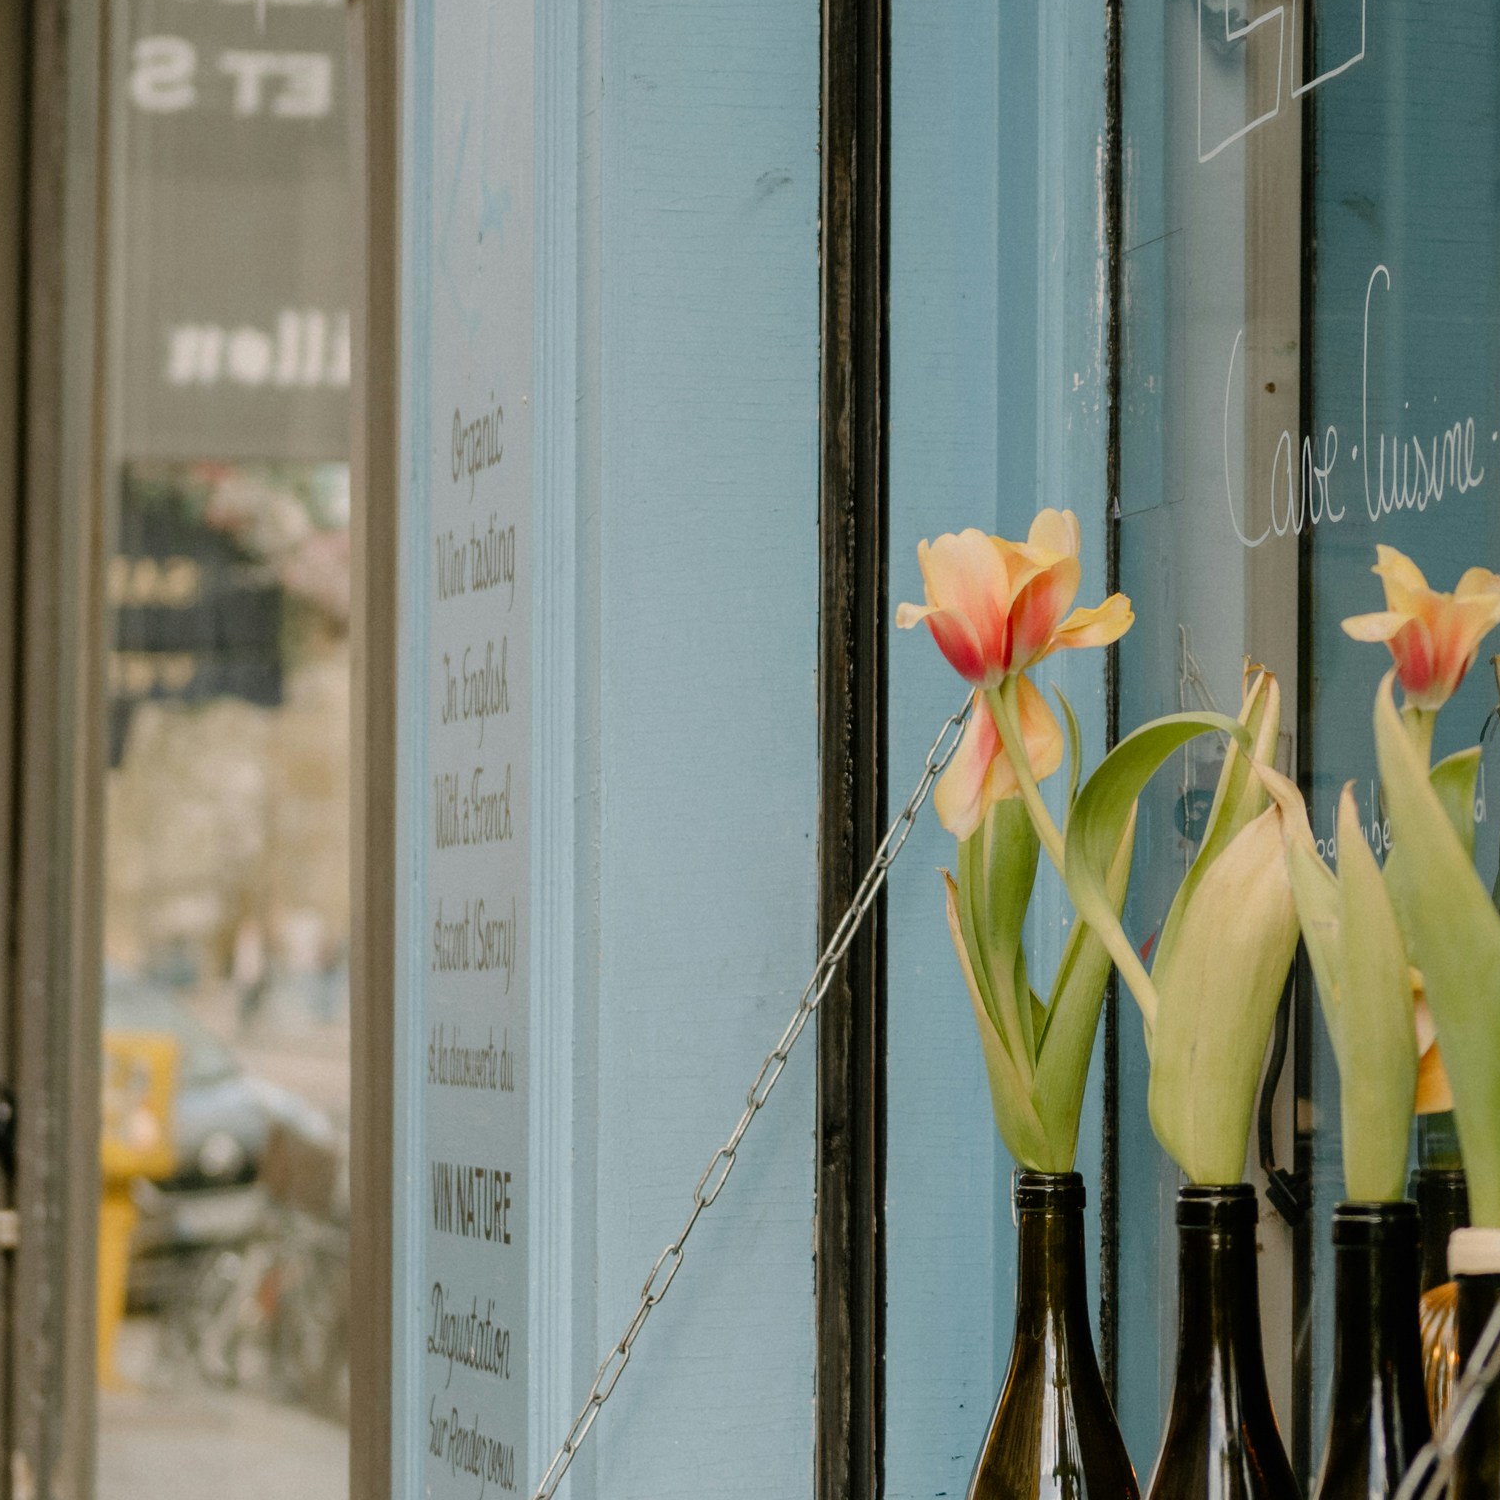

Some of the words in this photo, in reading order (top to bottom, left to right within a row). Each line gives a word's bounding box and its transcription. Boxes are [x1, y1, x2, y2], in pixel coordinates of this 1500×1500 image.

[451, 388, 504, 504] Organic
[1362, 263, 1485, 524] Cuisine
[435, 528, 467, 601] Wine
[469, 510, 516, 613] tasting
[462, 635, 510, 750] English
[462, 795, 470, 845] a
[471, 763, 514, 845] French
[500, 1027, 515, 1092] du
[431, 1160, 453, 1235] VIN
[456, 1165, 512, 1246] NATURE
[426, 1281, 511, 1390] Dégustation
